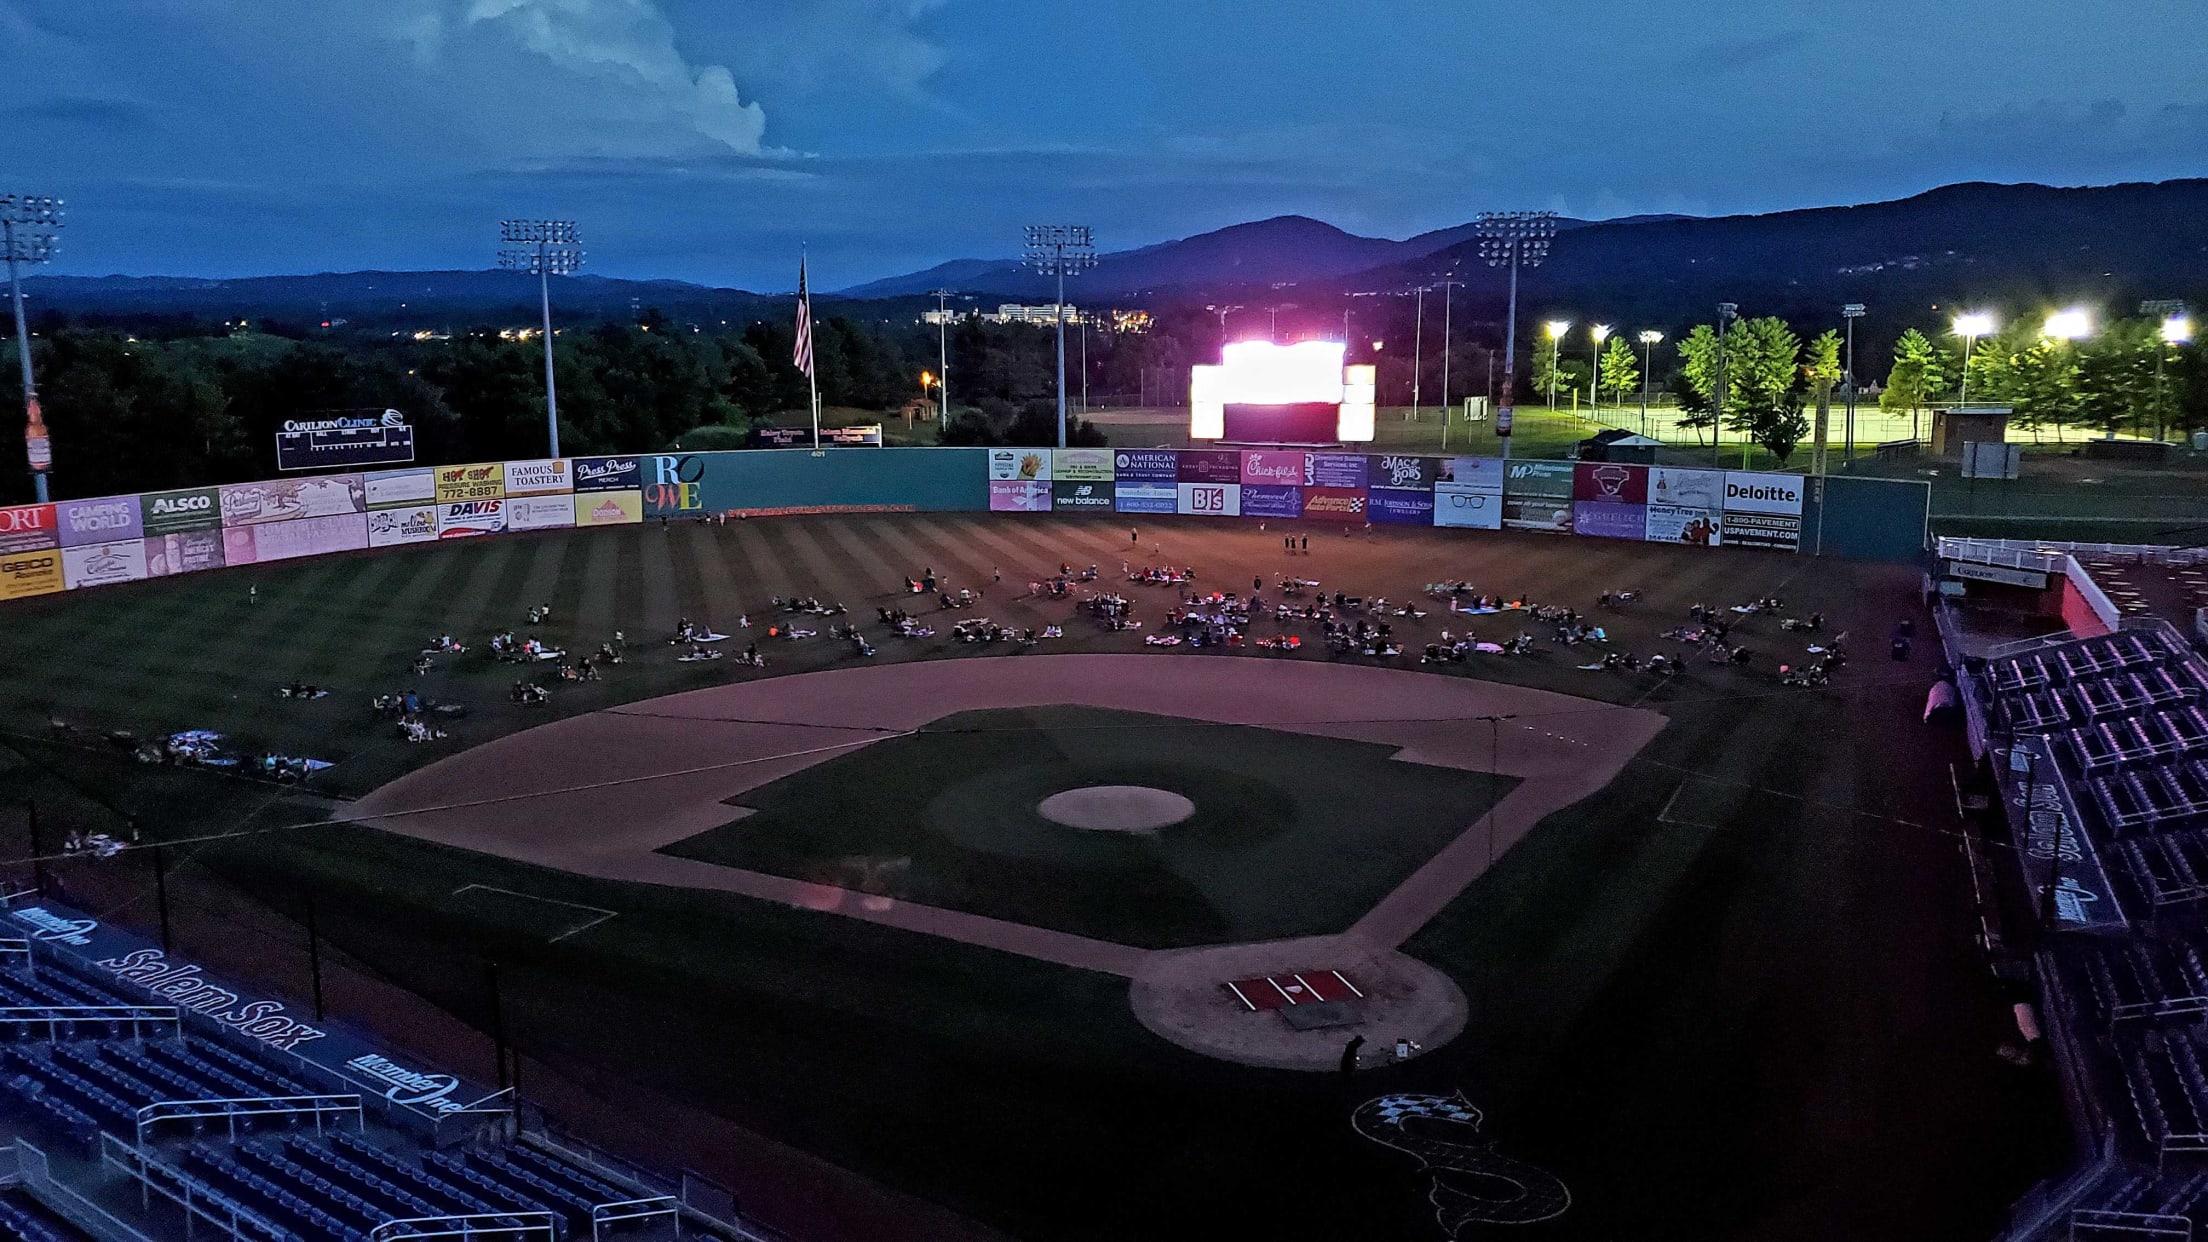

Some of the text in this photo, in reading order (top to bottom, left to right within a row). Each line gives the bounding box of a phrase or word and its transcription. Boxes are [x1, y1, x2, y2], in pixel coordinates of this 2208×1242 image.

[511, 465, 553, 477] FAMOUS
[1130, 461, 1175, 469] NATIONAL
[515, 474, 565, 486] TOASTERY
[442, 486, 498, 499] 772-8887
[993, 486, 1011, 494] Bank
[1011, 486, 1020, 494] of
[1056, 495, 1110, 505] new balance
[449, 500, 503, 516] DAVIS
[70, 513, 131, 532] WORLD
[1724, 526, 1799, 541] USPAVEMENT.COM
[2, 557, 53, 573] GEICO
[97, 949, 326, 1051] Salem Sox
[346, 1054, 444, 1093] Member
